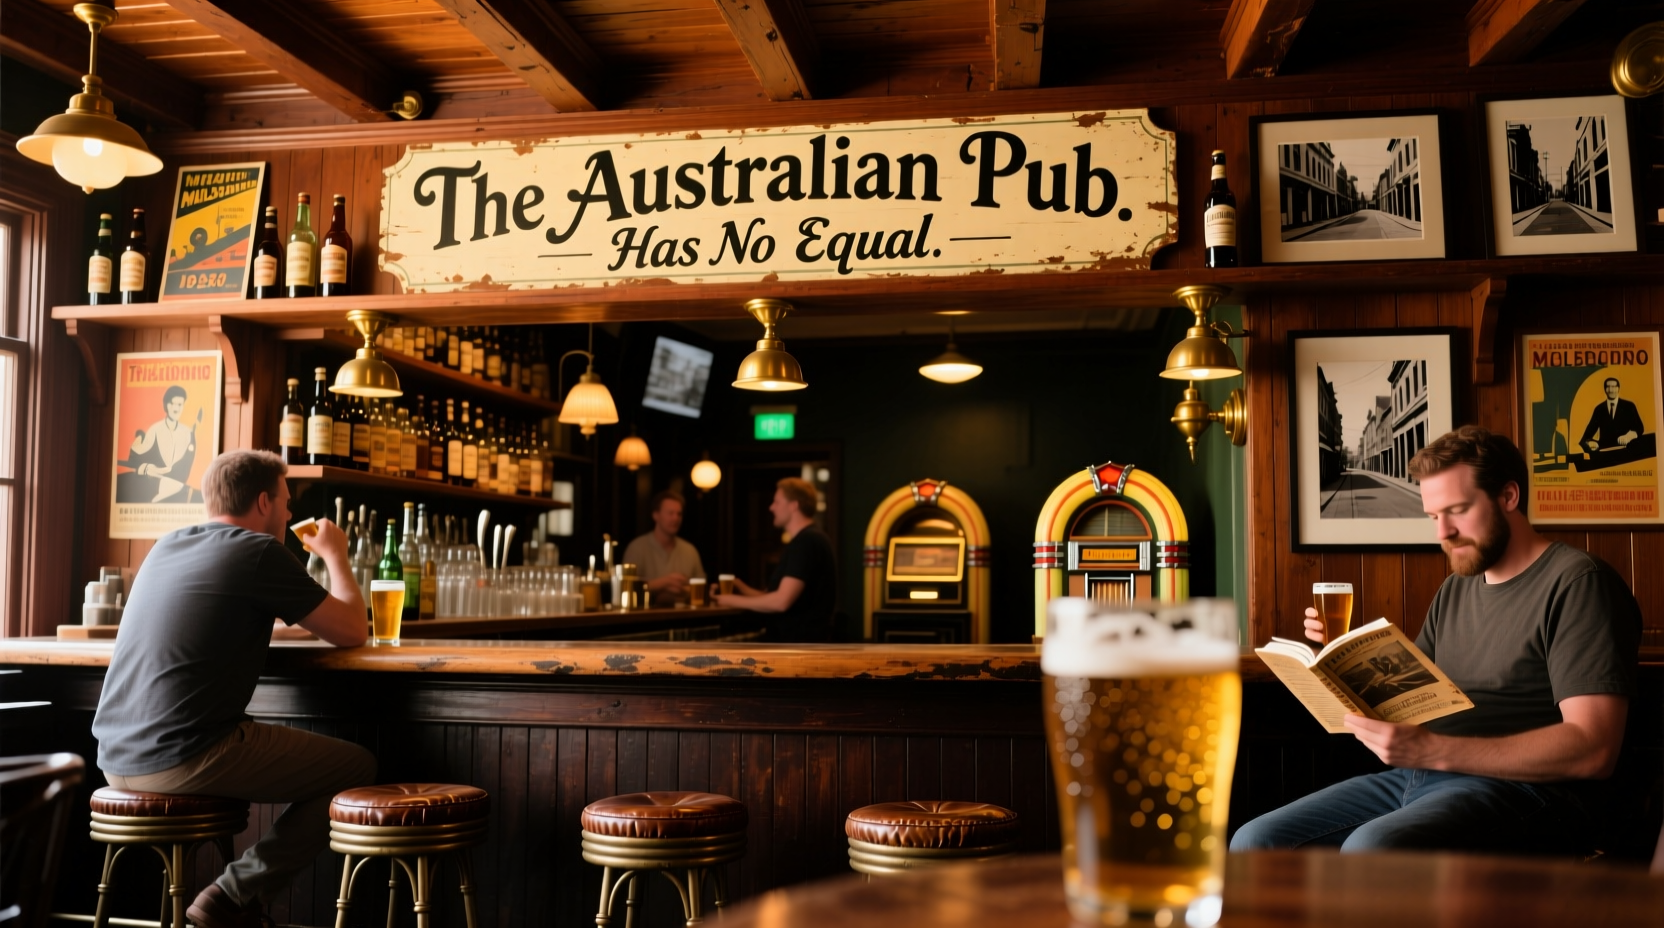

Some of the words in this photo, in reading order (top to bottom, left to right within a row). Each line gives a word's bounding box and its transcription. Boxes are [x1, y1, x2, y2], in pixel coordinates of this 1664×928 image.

[413, 160, 545, 250] The
[546, 134, 943, 245] Australian
[959, 130, 1134, 221] Pub.
[607, 225, 701, 270] Has
[708, 217, 776, 265] No
[796, 213, 942, 275] Equal.
